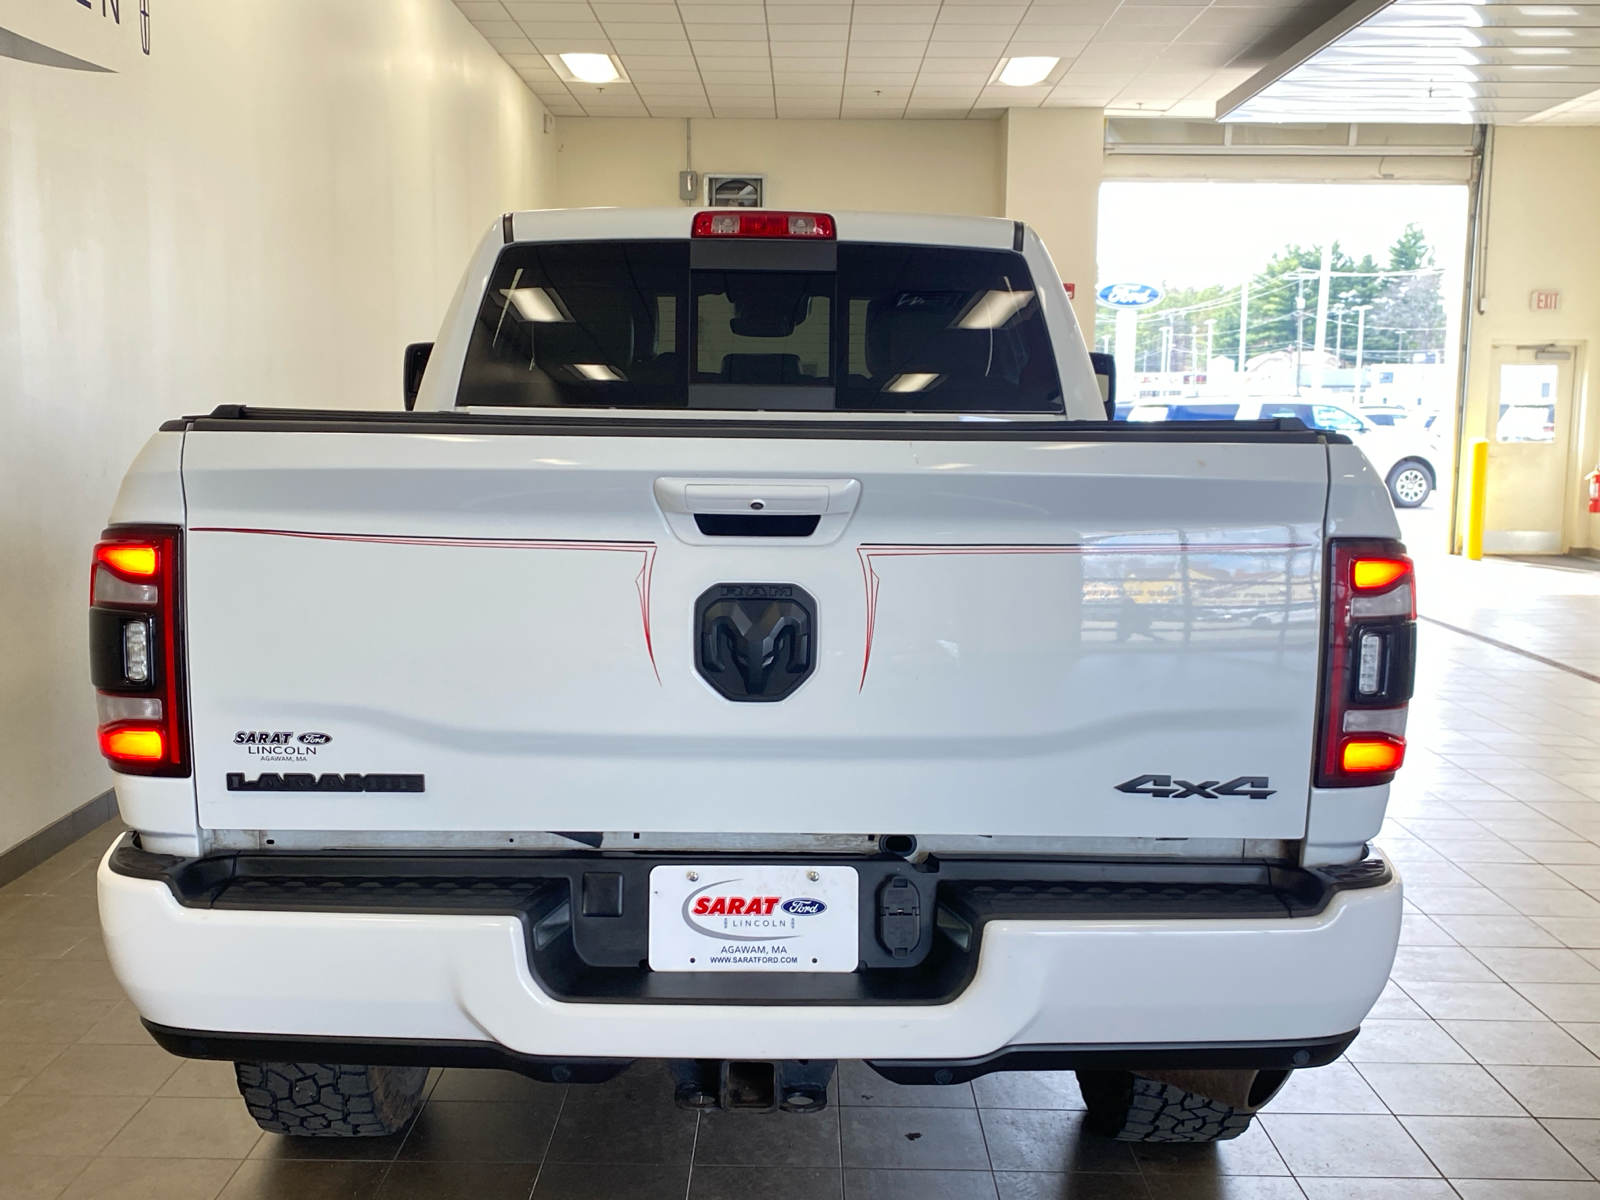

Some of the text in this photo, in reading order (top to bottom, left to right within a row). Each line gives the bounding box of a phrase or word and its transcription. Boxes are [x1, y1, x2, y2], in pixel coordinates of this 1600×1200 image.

[1536, 292, 1559, 310] EXIT
[720, 586, 793, 597] RAM
[233, 731, 294, 745] SARAT
[248, 745, 317, 755] LINCOLN
[260, 755, 308, 763] AGAWAM, MA
[692, 896, 782, 916] SARAT
[732, 919, 786, 928] LINCOLN
[720, 945, 788, 955] AGAWAM, MA
[710, 956, 798, 965] WWW.SARATFORD.COM
